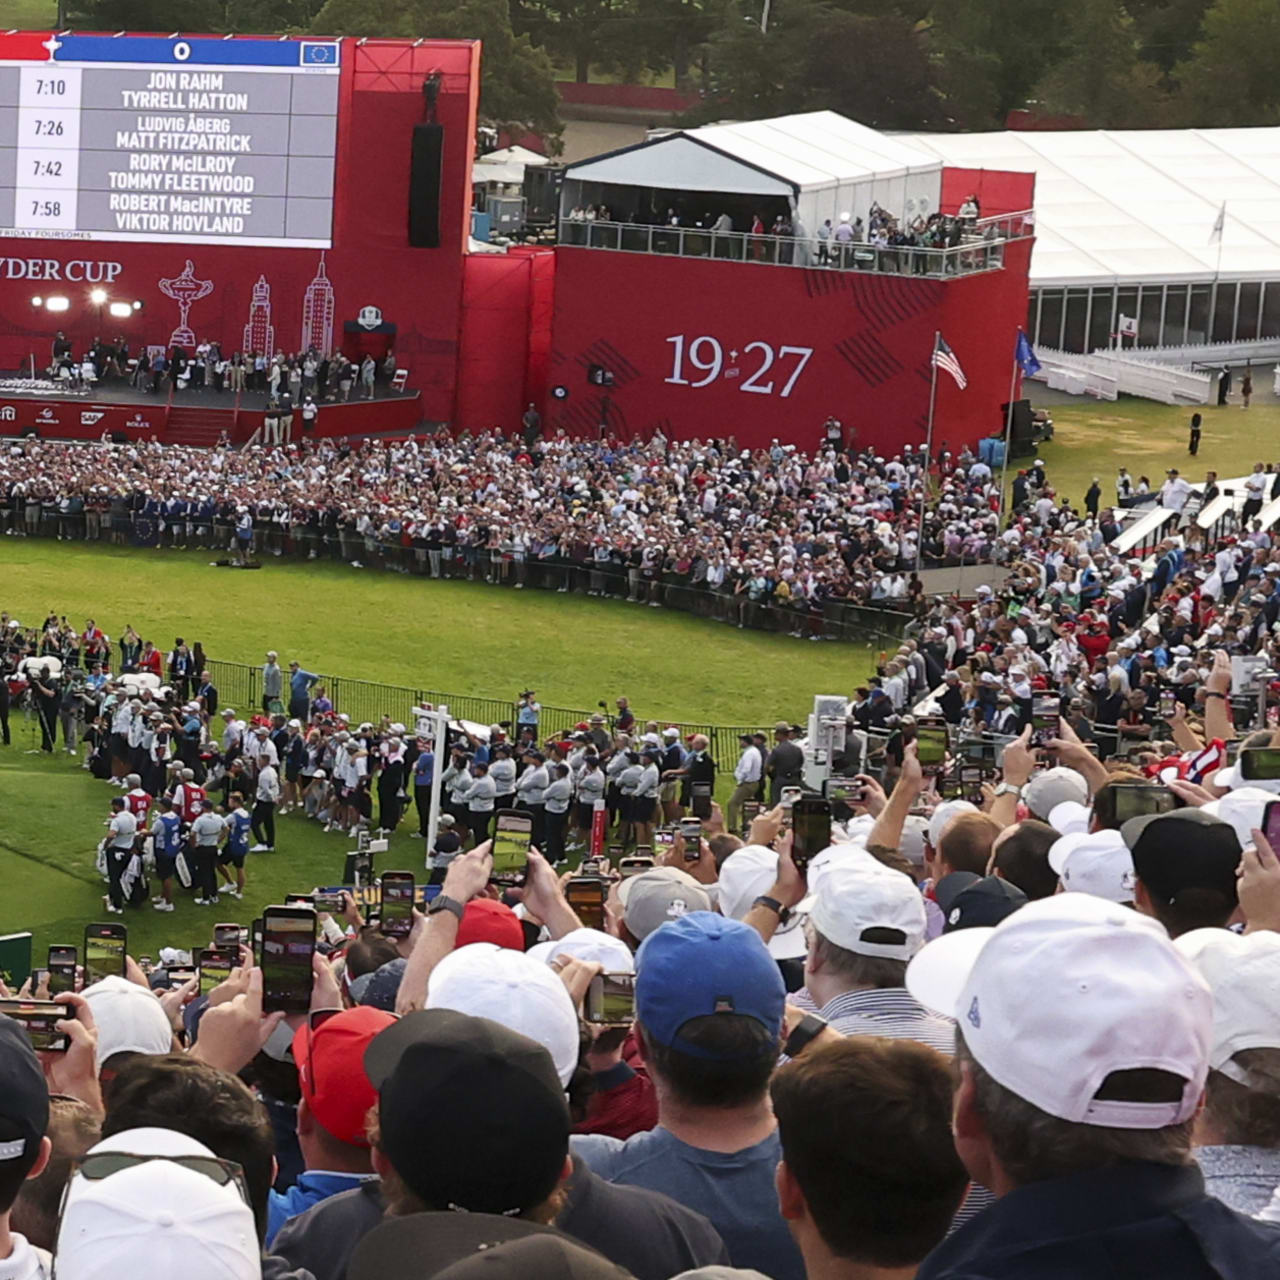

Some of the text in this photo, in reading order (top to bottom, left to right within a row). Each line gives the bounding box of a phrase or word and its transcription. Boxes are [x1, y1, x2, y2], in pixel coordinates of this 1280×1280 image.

[173, 43, 190, 60] 0
[37, 80, 66, 94] 7:10
[146, 72, 224, 90] JON RAHM
[121, 91, 248, 110] TYRRELL HATTON
[35, 121, 63, 135] 7:26
[137, 113, 231, 133] LUDVIG ÅBERG
[116, 132, 251, 151] MATT FITZPATRICK
[34, 161, 62, 175] 7:42
[129, 154, 236, 173] RORY McILROY
[108, 172, 255, 192] TOMMY FLEETWOOD
[32, 202, 61, 216] 7:58
[109, 194, 252, 216] ROBERT MacINTYRE
[115, 213, 244, 233] VIKTOR HOVLAND
[0, 229, 92, 239] FRIDAY FOURSOMES
[64, 260, 123, 284] CUP
